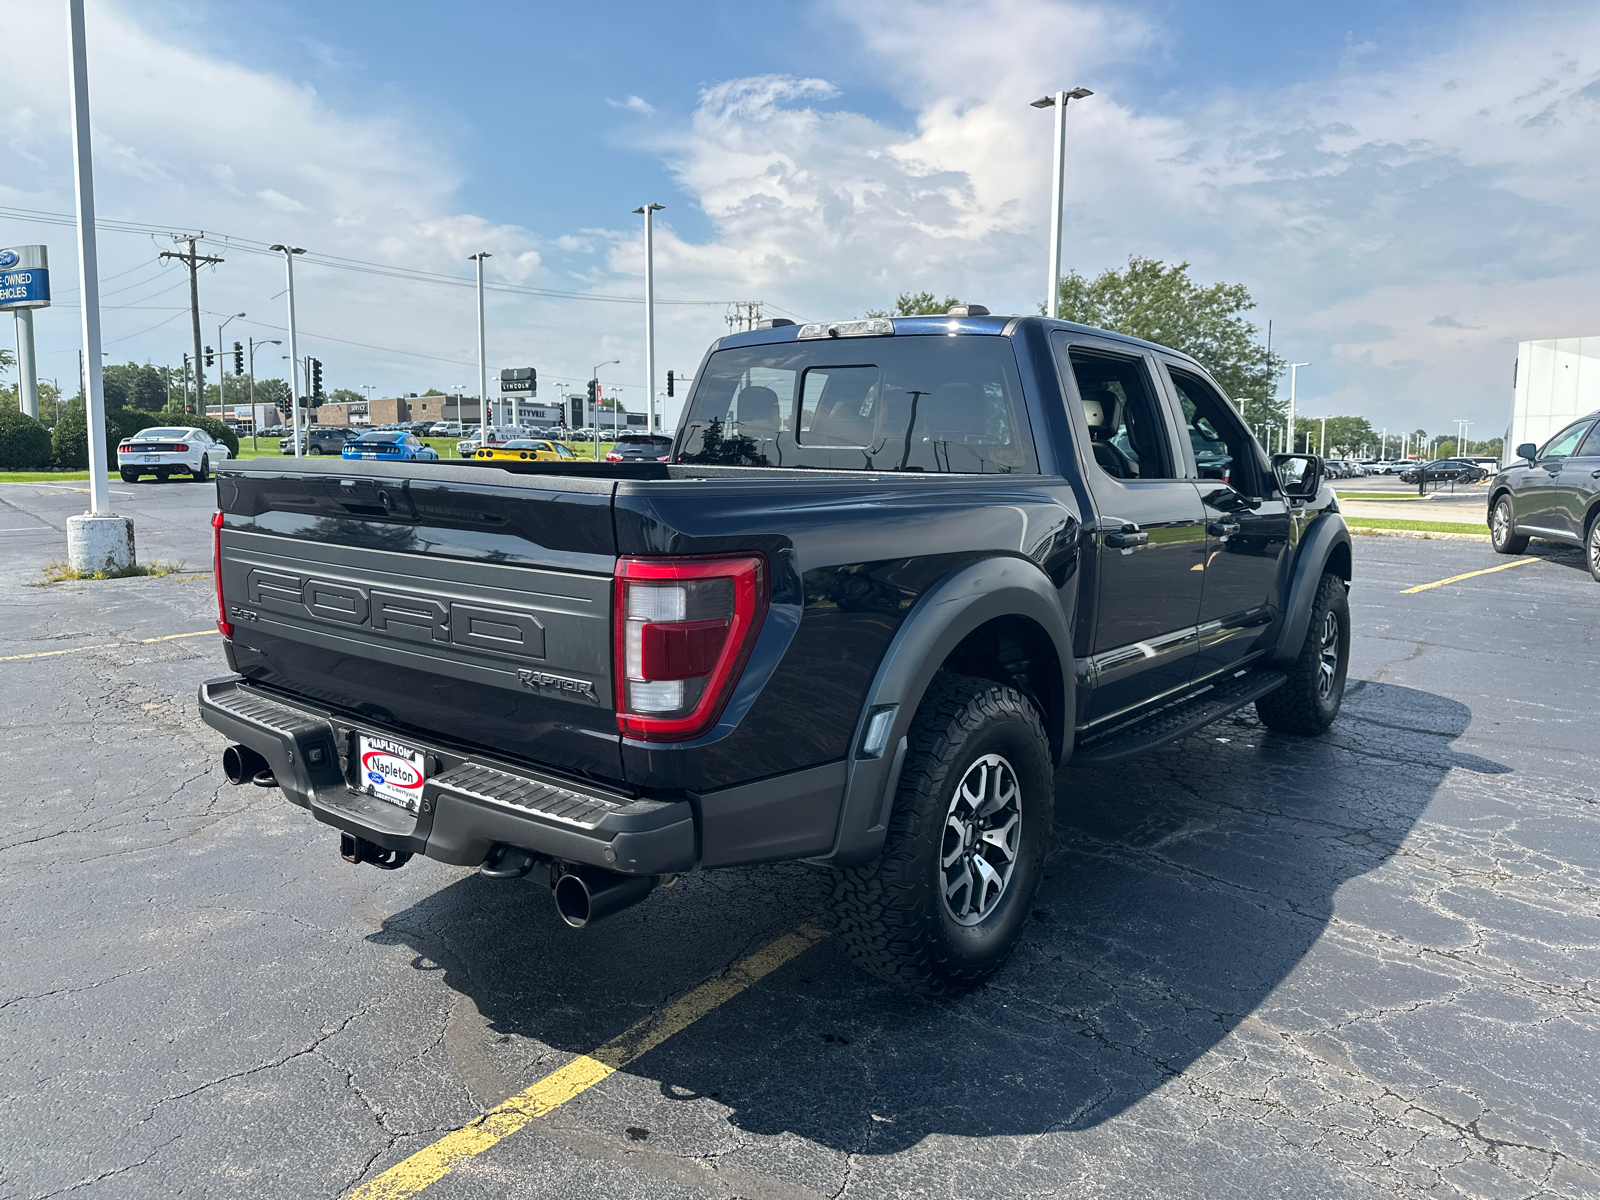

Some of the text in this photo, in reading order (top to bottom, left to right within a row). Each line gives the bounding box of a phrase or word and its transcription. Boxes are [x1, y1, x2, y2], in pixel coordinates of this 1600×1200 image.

[503, 382, 529, 390] LINCOLN
[247, 568, 546, 660] FORD
[517, 668, 599, 702] RAPTOR
[371, 738, 414, 759] NAPLETON
[370, 773, 383, 784] Ford
[372, 755, 414, 783] Napleton
[391, 786, 419, 800] Libertyville
